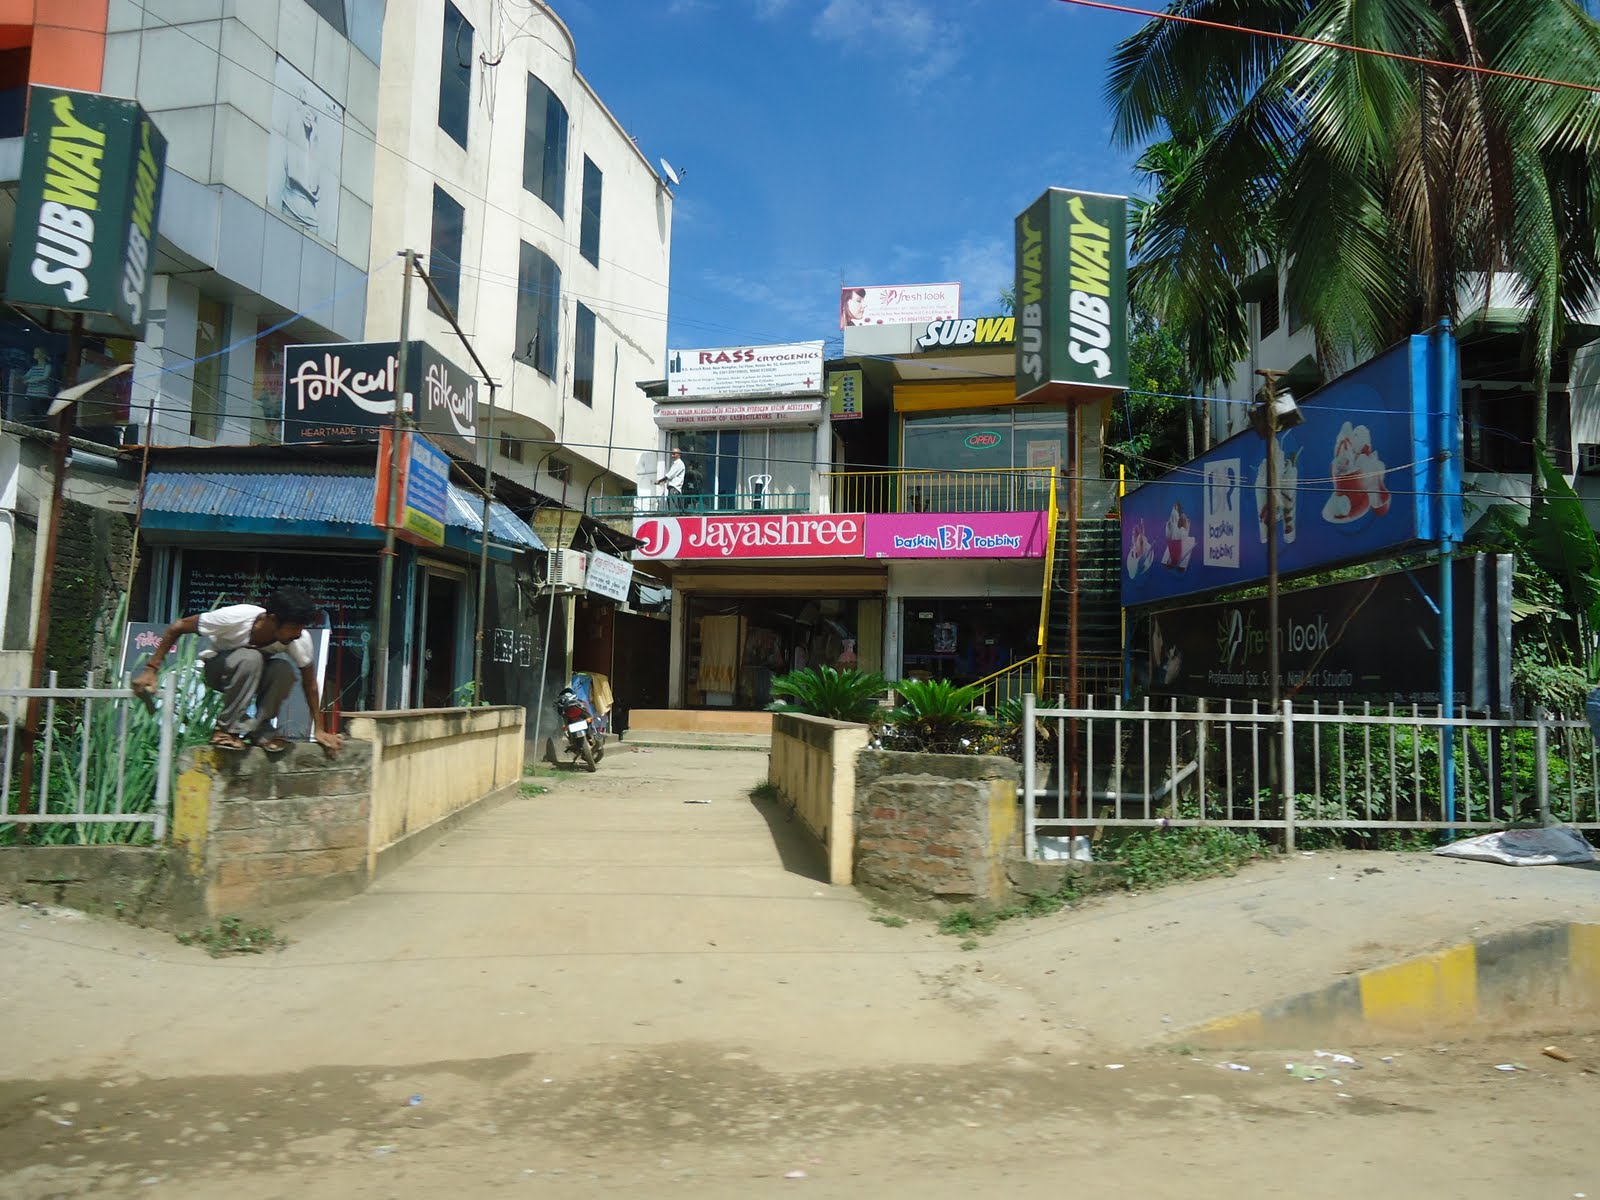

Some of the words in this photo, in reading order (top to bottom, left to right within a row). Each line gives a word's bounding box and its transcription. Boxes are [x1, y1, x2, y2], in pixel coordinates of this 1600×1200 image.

[31, 95, 106, 303] SUBWAY
[123, 121, 158, 325] SUBWAY
[924, 291, 945, 301] look
[1022, 213, 1043, 383] SUBWAY
[1066, 196, 1112, 379] SUBWAY
[917, 317, 1015, 348] SUBWA
[699, 349, 755, 365] RASS
[756, 352, 819, 362] CRYOGENICS
[425, 363, 476, 445] folkcult
[301, 426, 356, 437] HEARTMADE
[969, 435, 997, 445] OPEN
[689, 515, 857, 556] Jayashree
[894, 533, 938, 549] baskin
[937, 524, 974, 551] BR
[975, 534, 1020, 549] robbins
[1209, 520, 1234, 539] baskin
[1288, 615, 1330, 652] look
[1207, 669, 1245, 687] Professional
[1322, 668, 1353, 687] Studio
